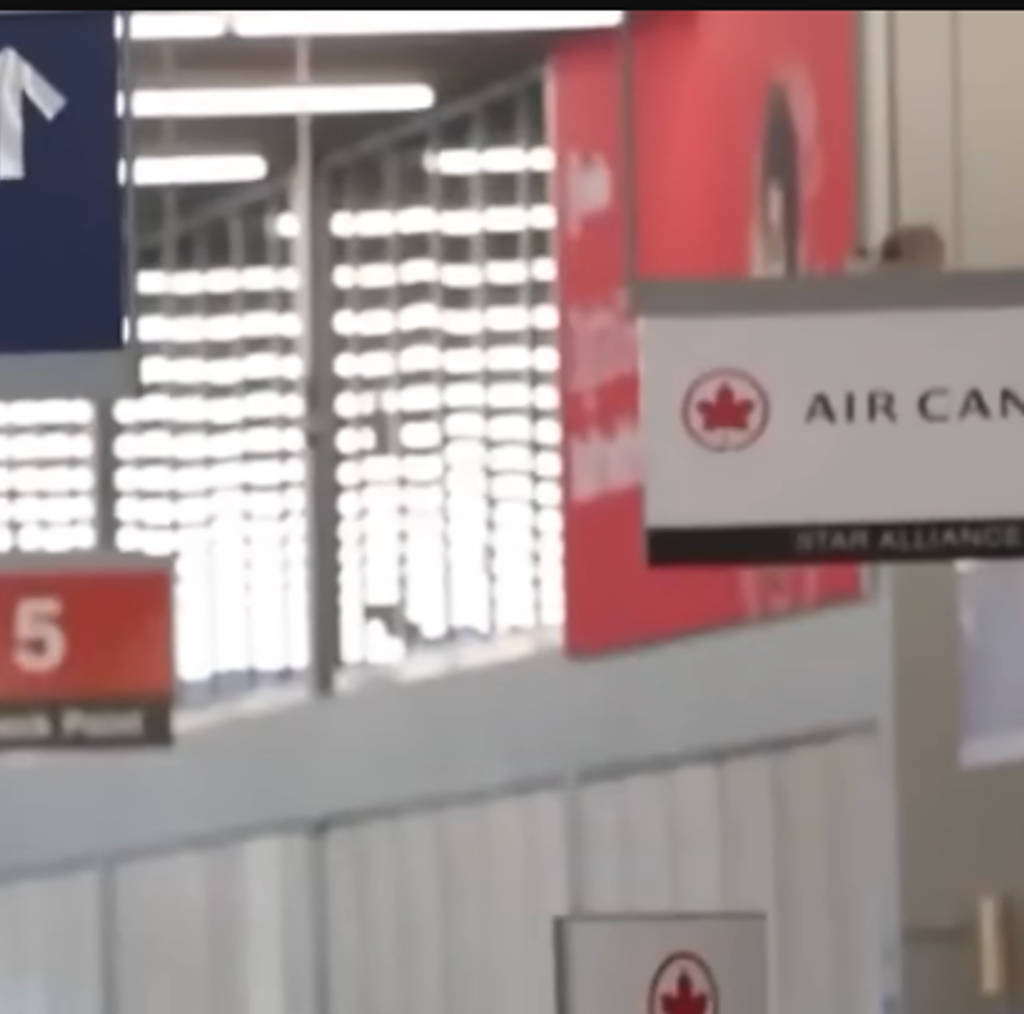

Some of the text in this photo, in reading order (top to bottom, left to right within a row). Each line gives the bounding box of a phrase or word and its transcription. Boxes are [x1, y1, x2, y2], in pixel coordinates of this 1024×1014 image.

[804, 391, 898, 425] AIR
[796, 532, 870, 553] STAR
[12, 596, 66, 673] 5
